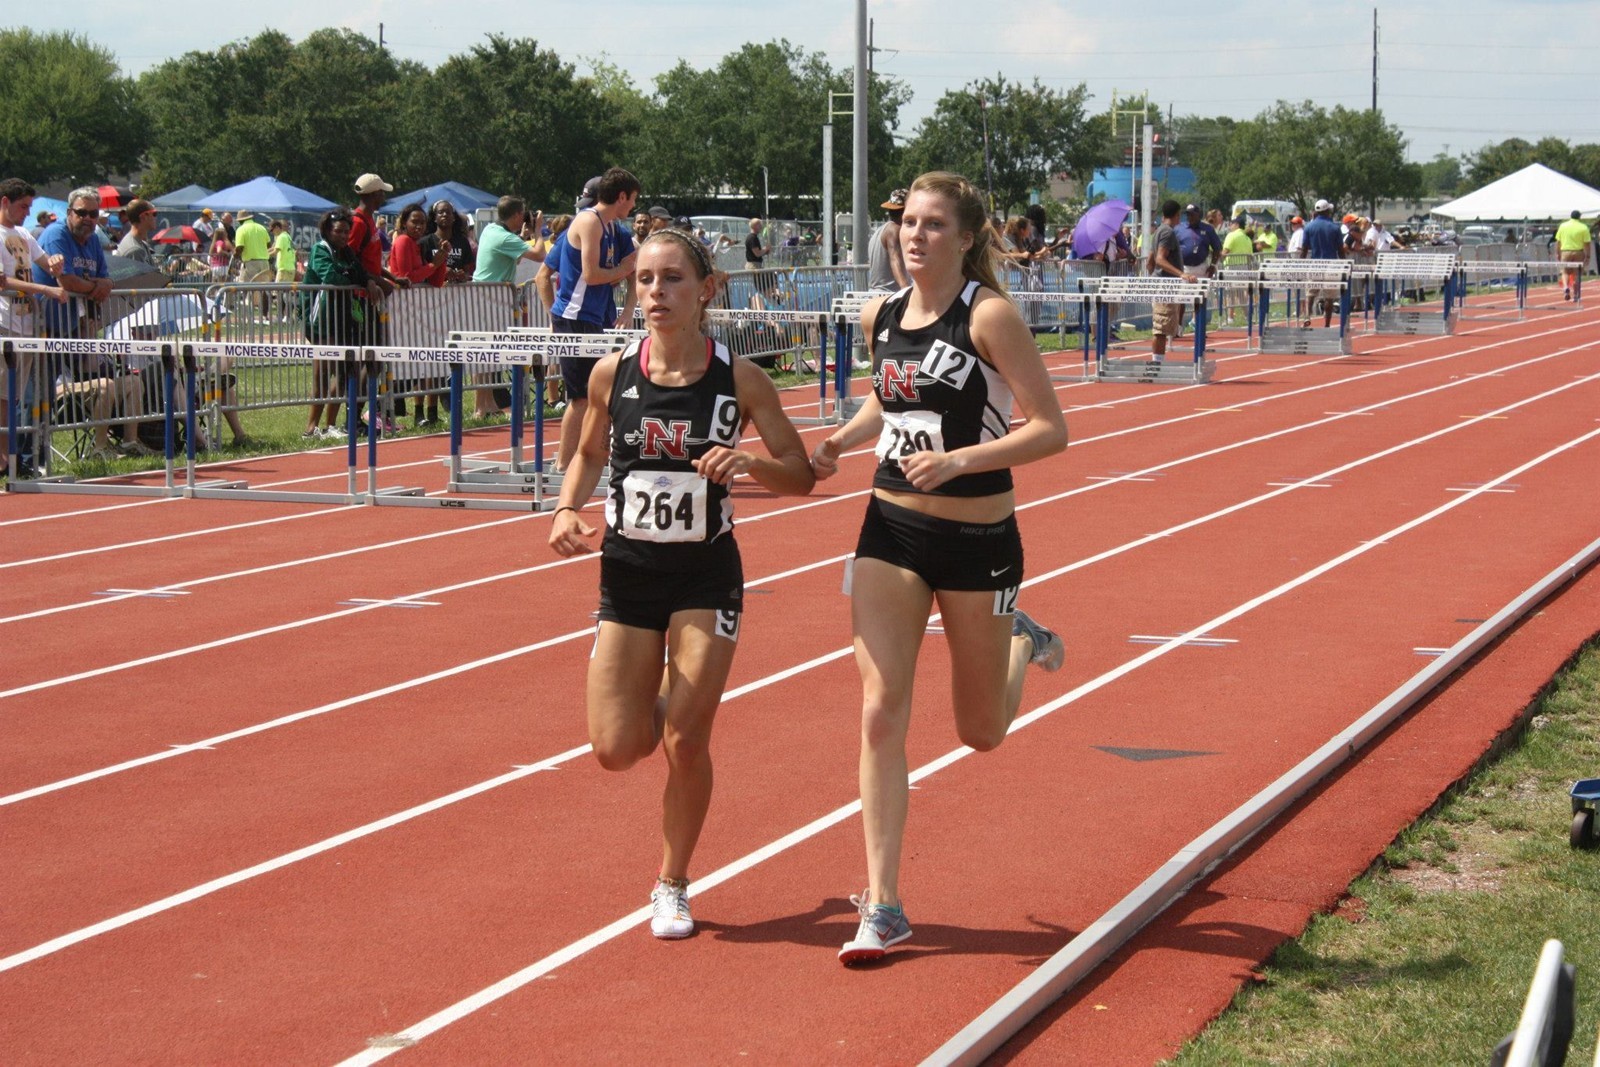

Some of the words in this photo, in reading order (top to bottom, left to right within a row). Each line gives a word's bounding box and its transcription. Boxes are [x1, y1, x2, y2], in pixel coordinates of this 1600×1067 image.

[729, 312, 768, 320] MCNEESE
[45, 341, 96, 352] MCNEESE
[100, 342, 131, 353] STATE
[225, 345, 278, 357] MCNEESE
[281, 347, 314, 358] STATE
[409, 350, 462, 362] MCNEESE
[466, 351, 500, 363] STATE
[547, 345, 580, 356] STATE
[928, 345, 966, 385] 12
[881, 359, 921, 402] N
[716, 400, 740, 441] 9
[640, 417, 691, 460] N
[635, 491, 693, 530] 264
[960, 526, 985, 535] NIKE
[986, 525, 1005, 535] PRO
[999, 586, 1018, 614] 12
[721, 609, 739, 636] 9
